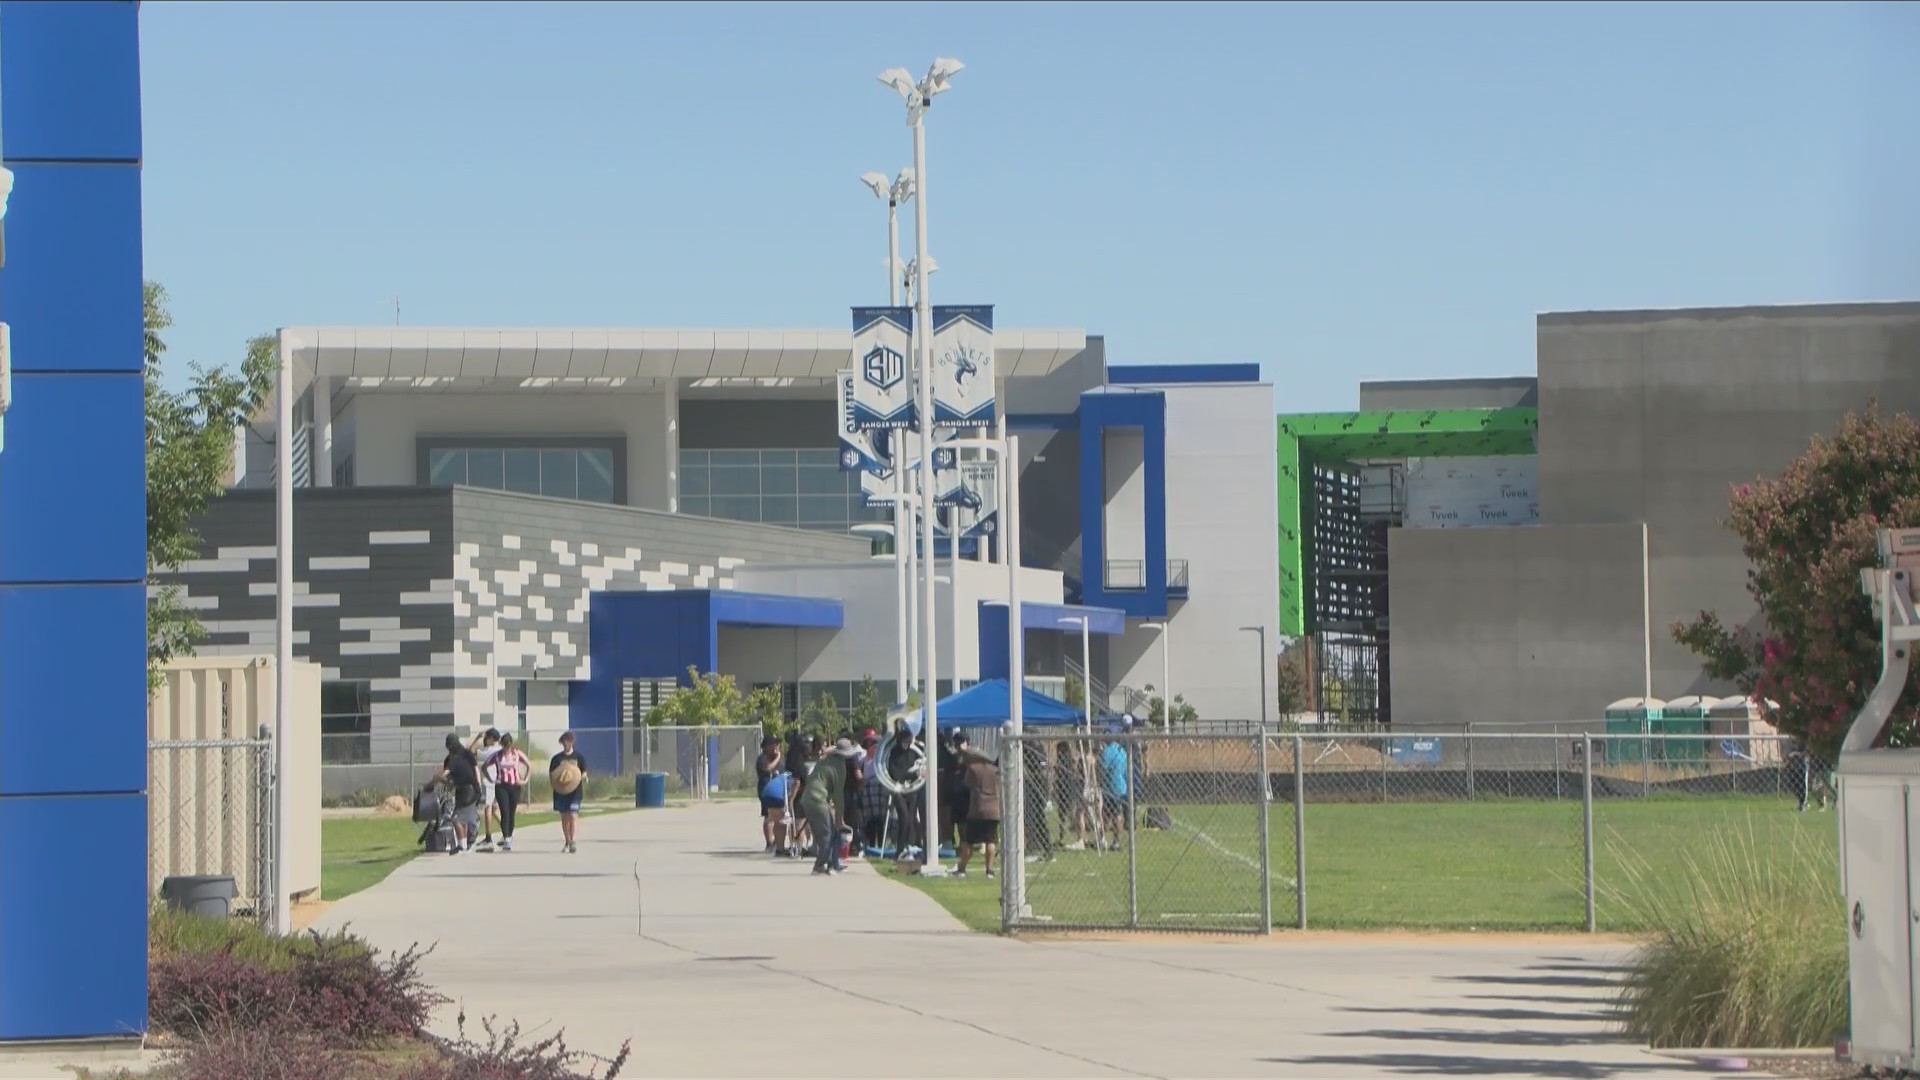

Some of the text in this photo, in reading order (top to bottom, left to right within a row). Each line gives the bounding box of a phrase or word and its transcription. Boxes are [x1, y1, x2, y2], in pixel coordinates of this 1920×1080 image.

[937, 347, 991, 367] HORNETS
[890, 420, 909, 428] WEST
[970, 419, 989, 427] WEST
[1501, 488, 1528, 498] Tyvek
[1430, 511, 1458, 521] Tyvek
[1479, 510, 1508, 521] Tyvek
